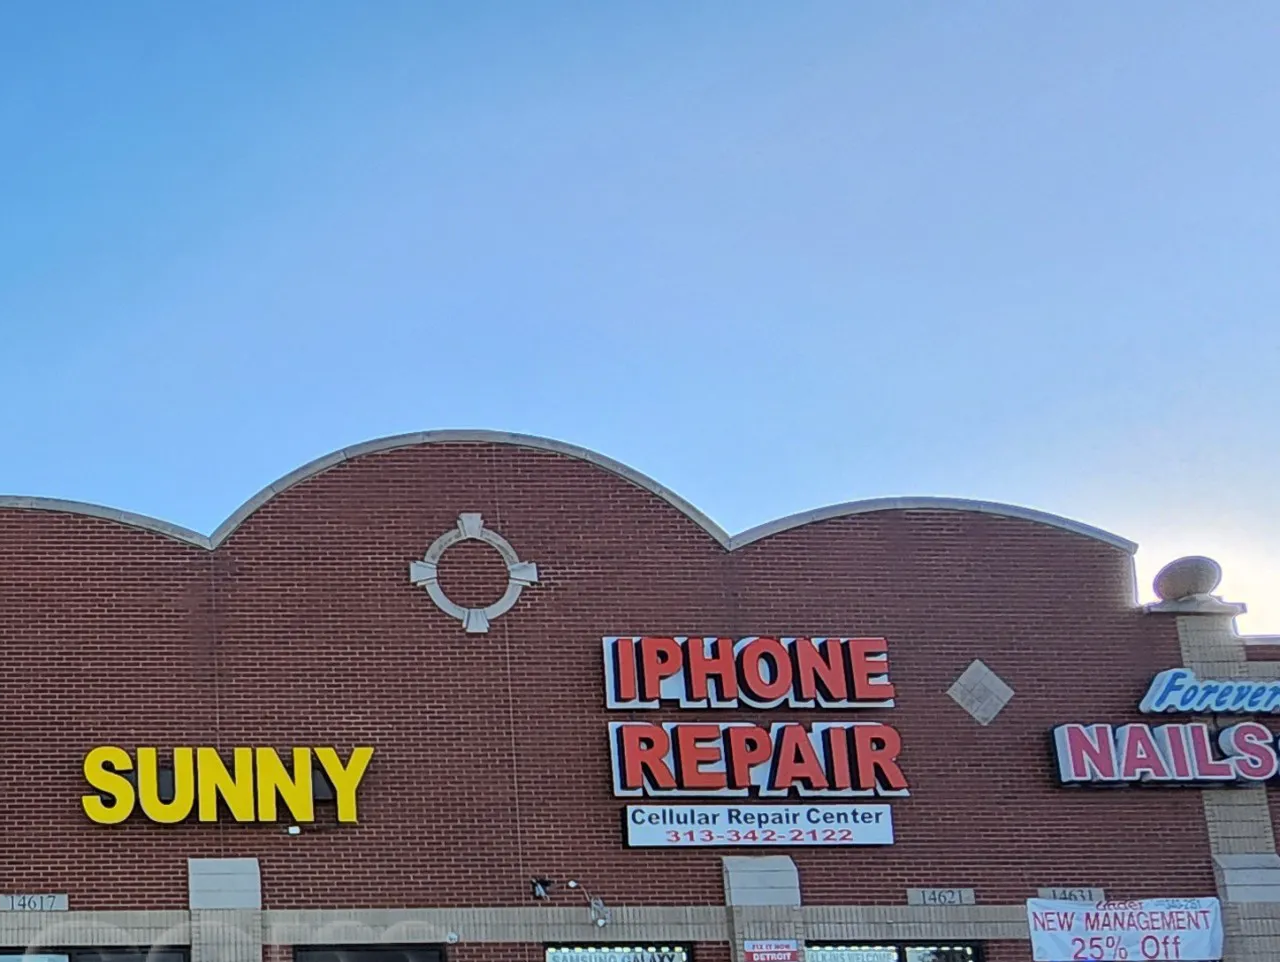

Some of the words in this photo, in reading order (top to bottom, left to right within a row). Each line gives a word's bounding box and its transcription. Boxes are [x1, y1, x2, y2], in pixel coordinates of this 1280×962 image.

[611, 637, 896, 703] IPHONE
[616, 723, 909, 792] REPAIR
[1057, 722, 1278, 782] NAILS
[81, 746, 375, 824] SUNNY
[631, 808, 720, 826] Cellular
[727, 808, 800, 828] Repair
[806, 807, 884, 825] Center
[666, 829, 854, 842] 313-342-2122
[9, 895, 57, 911] 14617
[920, 888, 964, 905] 14621
[1032, 911, 1076, 932] NEW
[1085, 910, 1211, 931] MANAGEMENT
[753, 952, 792, 961] DETROIT
[1071, 936, 1128, 961] 25%
[1141, 934, 1181, 960] Off
